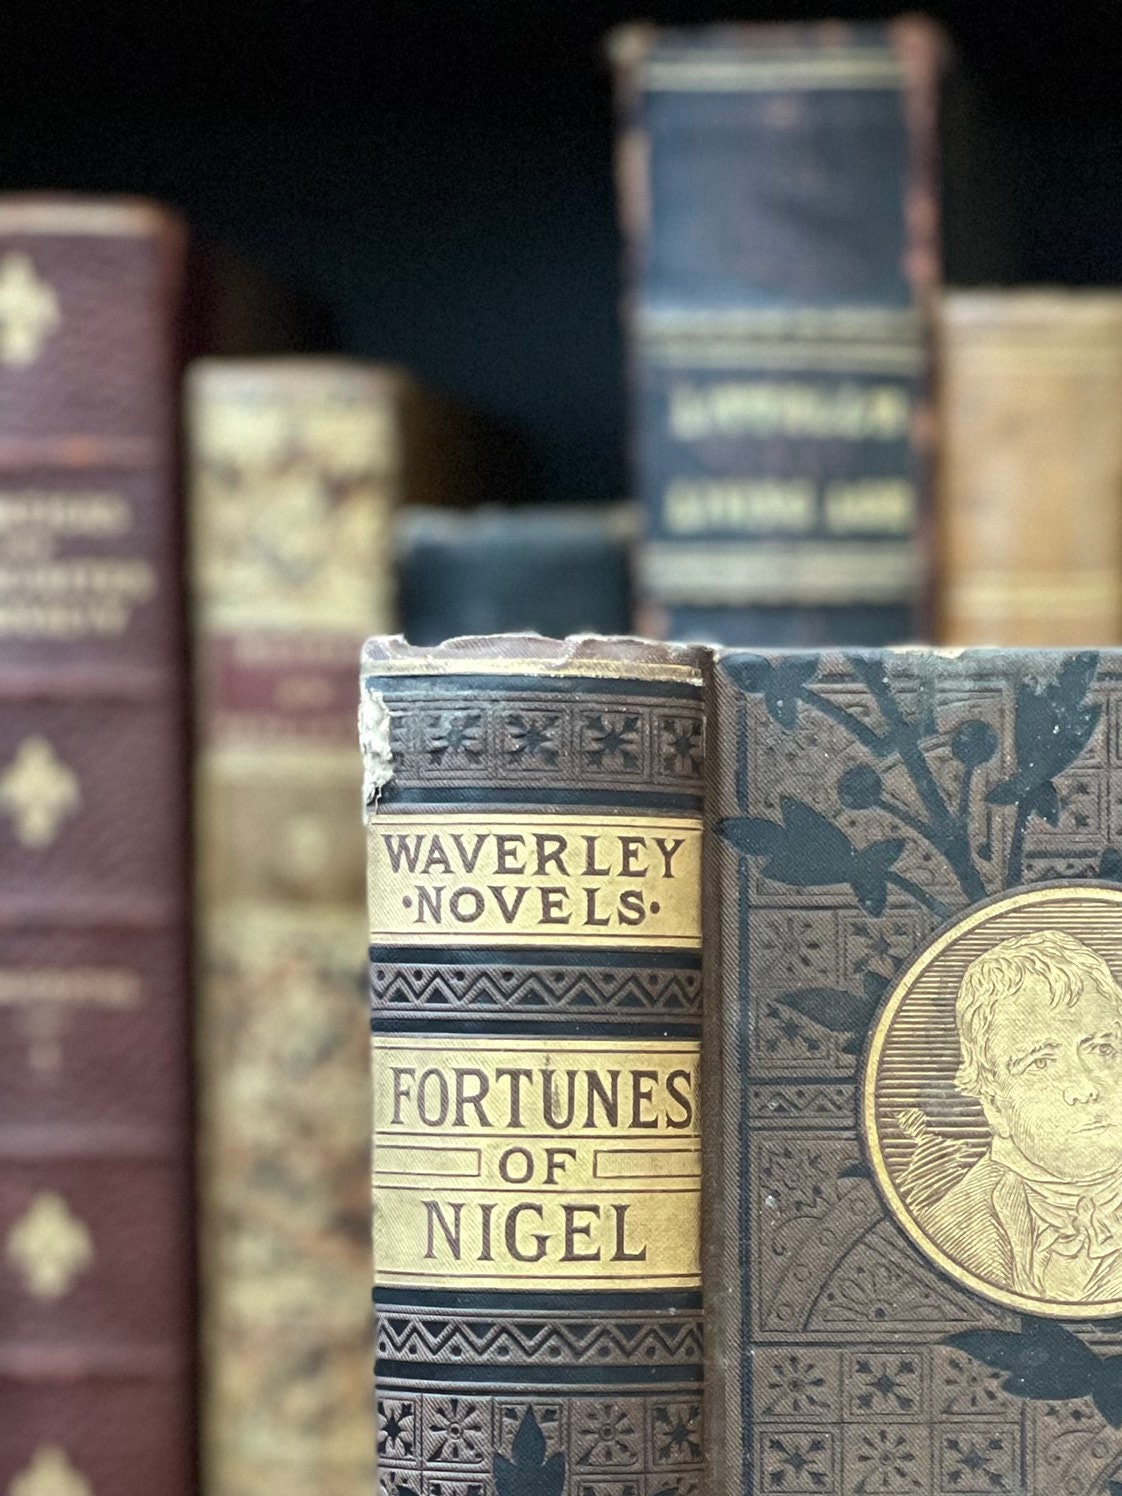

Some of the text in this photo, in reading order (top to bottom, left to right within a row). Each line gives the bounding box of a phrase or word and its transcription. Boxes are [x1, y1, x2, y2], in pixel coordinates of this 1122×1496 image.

[381, 834, 686, 878] WAVERLEY
[389, 1066, 694, 1130] FORTUNES
[498, 1146, 577, 1185] OF
[421, 1200, 647, 1262] NIGEL
